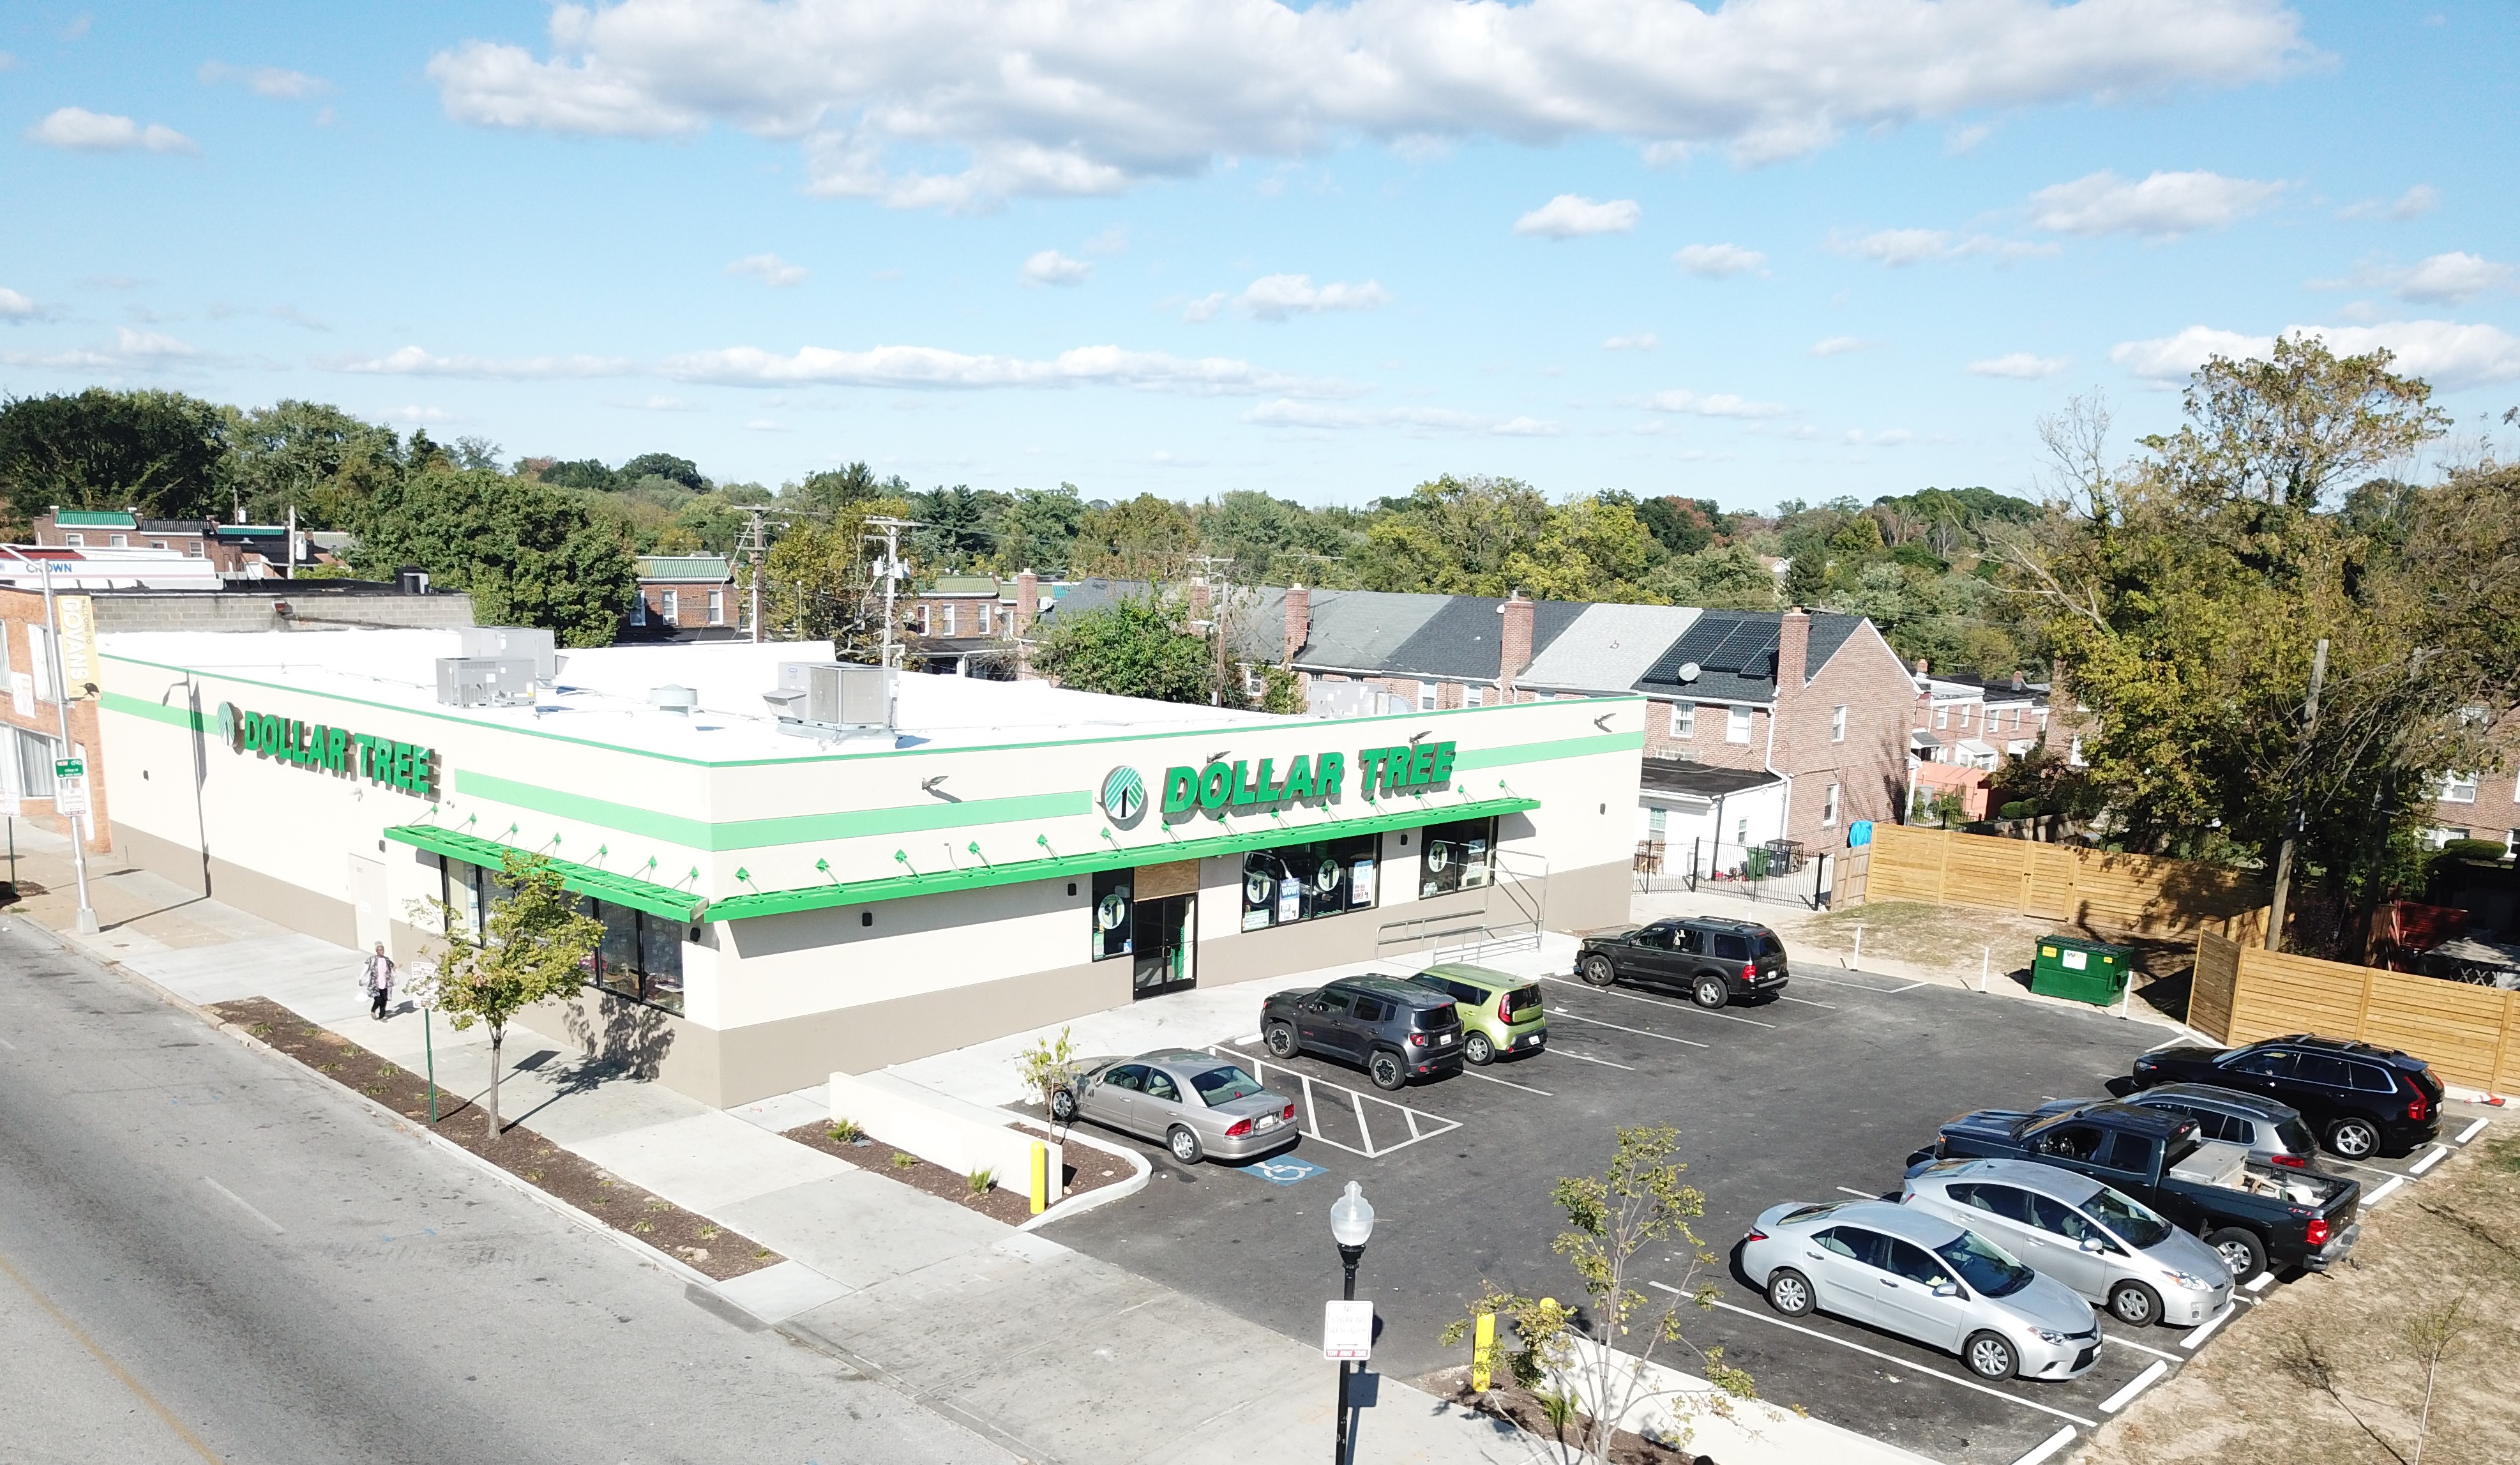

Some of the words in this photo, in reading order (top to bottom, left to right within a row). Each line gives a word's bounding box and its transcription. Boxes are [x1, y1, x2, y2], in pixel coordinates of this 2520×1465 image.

[61, 598, 89, 681] GOVANS
[81, 599, 91, 632] WELCOME
[86, 636, 92, 644] TO
[245, 710, 346, 772] DOLLAR
[354, 732, 430, 794] TREE
[1163, 752, 1344, 814] DOLLAR
[1362, 741, 1456, 791] TREE
[1104, 900, 1118, 927] $1
